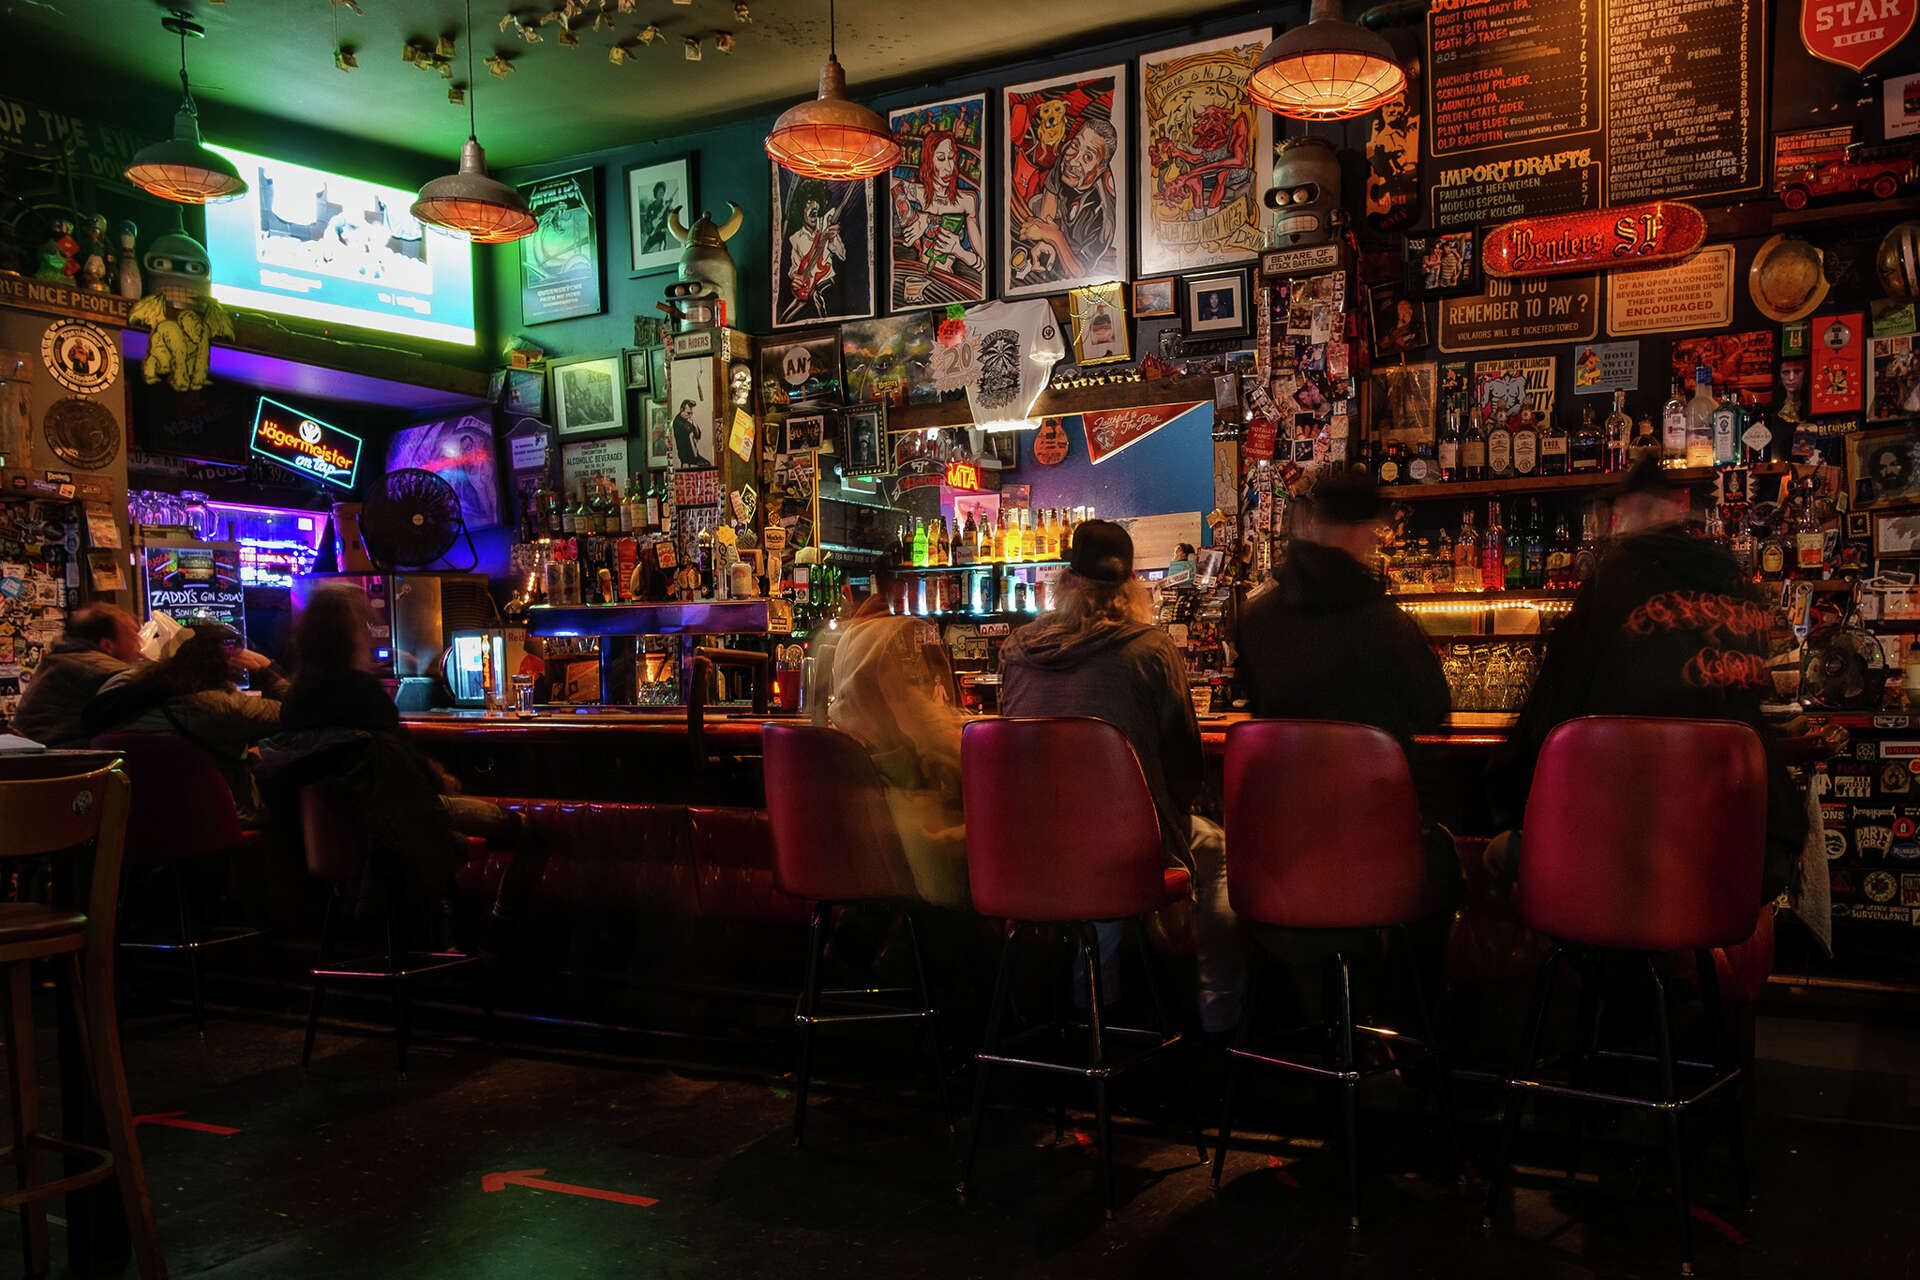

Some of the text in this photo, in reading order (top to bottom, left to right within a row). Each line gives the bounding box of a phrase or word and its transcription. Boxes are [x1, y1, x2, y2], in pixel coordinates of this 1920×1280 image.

[1434, 0, 1529, 27] GHOST TOWN IPA
[1815, 0, 1901, 32] STAR
[1473, 20, 1488, 31] IPA
[1610, 24, 1688, 46] PACIFICO CERVEZA
[1434, 37, 1462, 51] DEATH
[1478, 27, 1508, 42] TAXES
[1610, 42, 1643, 55] CORONA
[1840, 30, 1878, 46] BEER
[1610, 45, 1676, 65] NEGRA MODELO
[1610, 47, 1722, 74] HEINEKEN PERONI
[1436, 66, 1503, 89] ANCHOR STEAM
[1610, 65, 1673, 84] AMSTEL LIGHT
[1610, 76, 1661, 94] LA CHOUFFE
[1150, 74, 1185, 101] There
[1435, 74, 1529, 101] SCRIMSHAW PILSNER
[1610, 80, 1694, 102] NEWCASTLE BROWN
[1437, 92, 1498, 113] LAGUNITAS IPA
[1644, 92, 1678, 105] CHIMAY
[1437, 100, 1525, 126] GOLDEN STATE CIDER
[1610, 105, 1652, 121] LA MARCA
[1610, 103, 1719, 129] OMMEGANG CHERRY SOUR
[39, 109, 89, 148] THE
[1437, 116, 1509, 138] PLINY THE ELDER
[1610, 123, 1652, 138] DUCHESSE
[1665, 113, 1716, 130] BOURGOGNE
[1674, 125, 1706, 138] TECATE
[1437, 130, 1503, 151] OLD RASPUTIN
[1610, 140, 1661, 157] GRAPEFRUIT
[1662, 135, 1697, 149] RADLER
[1439, 147, 1592, 188] IMPORT DRAFTS
[1610, 157, 1738, 185] CRISPIN BLACKBERRY PEAR CIDER
[1611, 149, 1722, 176] ANCHOR CALIFORNIA LAGER
[1629, 166, 1738, 190] MAIDEN THE TROOPER ESB
[1439, 176, 1541, 202] PAULANER HEFEWEISEN
[1440, 192, 1517, 215] MODELO ESPECIAL
[1440, 210, 1487, 226] REISSDORF
[1511, 206, 1667, 270] Benders SF
[1267, 255, 1334, 271] ATTACK BARTENDER
[1271, 248, 1329, 264] BEWARE OF
[1488, 277, 1547, 298] DID YOU
[1616, 281, 1725, 300] BEVERAGE CONTAINER UPON
[1618, 272, 1723, 291] OF AN OPEN ALCOHOLIC
[26, 284, 69, 306] NICE
[1626, 291, 1713, 307] THESE PREMISES IS
[1449, 293, 1590, 326] REMEMBER TO PAY ?
[1625, 299, 1714, 318] ENCOURAGED
[1617, 318, 1647, 328] SOBRIETY
[1655, 315, 1684, 325] STRICTLY
[1684, 311, 1721, 321] PROHIBITED
[677, 335, 711, 350] NO RIDERS
[1457, 322, 1580, 343] VIOLATORS WILL BE TICKETED/TOWED
[942, 342, 973, 375] 20
[1502, 359, 1520, 370] JAMES
[1520, 357, 1552, 369] WILLIAMSON
[1602, 359, 1635, 369] SWEET
[1603, 350, 1634, 361] HOME
[1525, 369, 1550, 390] KILL
[1603, 368, 1634, 379] HOME
[1092, 410, 1130, 433] Faithful
[1120, 413, 1162, 435] The Bay
[257, 419, 353, 470] Jägermeister
[566, 452, 624, 466] ALCOHOLIC BEVERAGES
[151, 588, 216, 607] ZADDY'S GIN
[1855, 826, 1893, 841] PARTY
[1850, 909, 1911, 921] SURVEILLANCE
